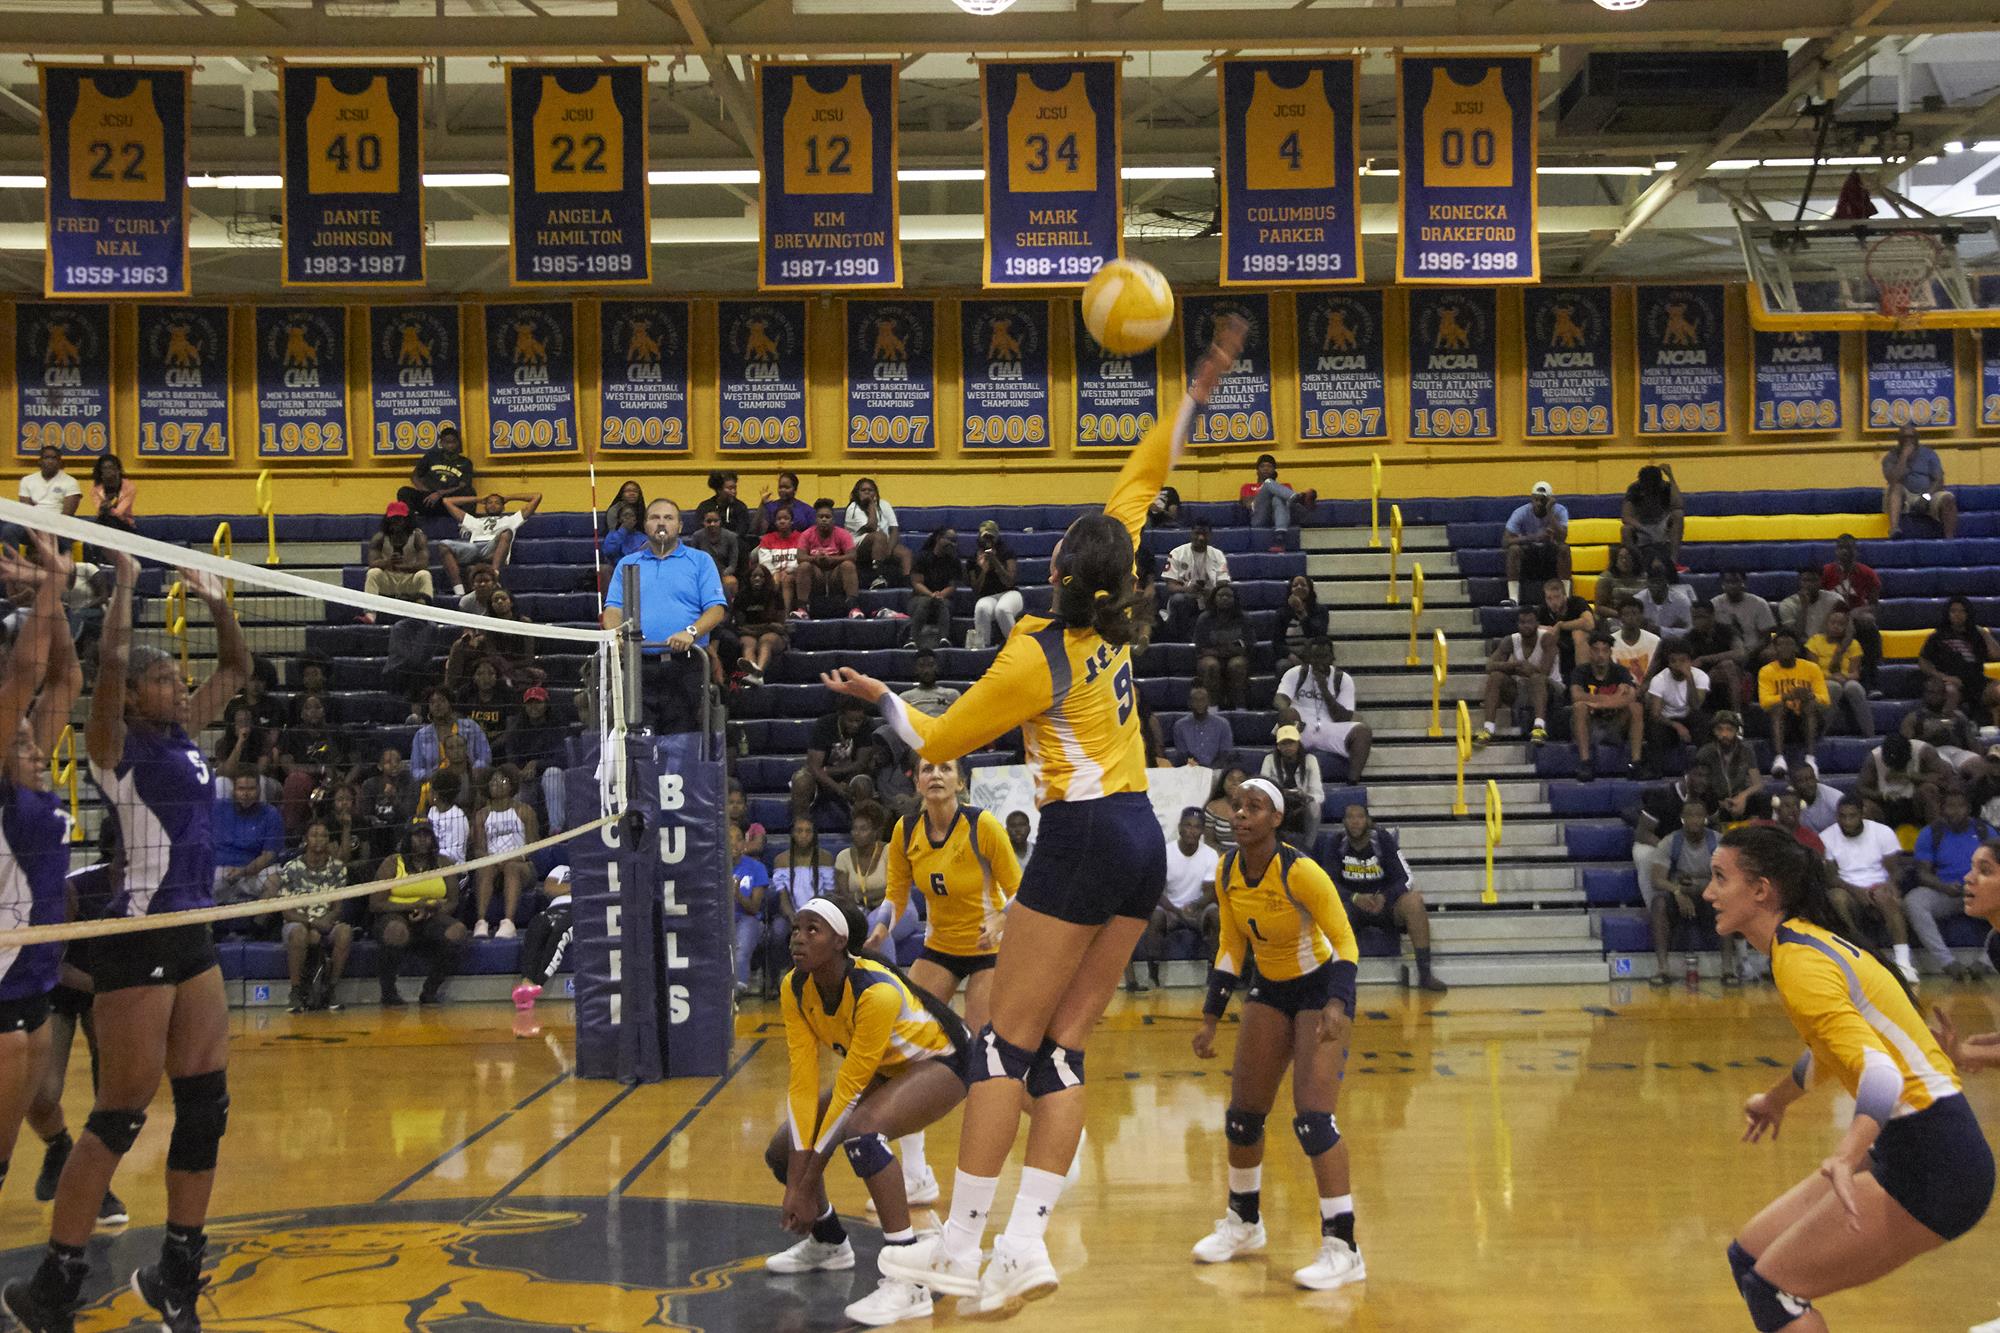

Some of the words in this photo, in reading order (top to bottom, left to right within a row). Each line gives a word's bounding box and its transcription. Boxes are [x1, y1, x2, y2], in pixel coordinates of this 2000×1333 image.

[336, 109, 369, 121] JCSU
[561, 108, 594, 122] JCSU
[811, 108, 844, 122] JCSU
[1035, 106, 1067, 120] JCSU
[1273, 105, 1306, 117] JCSU
[1451, 101, 1483, 114] JCSU
[100, 113, 133, 127] JCSU
[325, 134, 382, 173] 40
[550, 134, 607, 173] 22
[805, 135, 852, 176] 12
[1025, 132, 1079, 174] 34
[1279, 130, 1303, 171] 4
[1440, 128, 1495, 168] 00
[90, 142, 146, 181] 22
[323, 210, 380, 225] DANTE
[547, 209, 613, 224] ANGELA
[813, 212, 845, 227] KIM
[1029, 209, 1078, 225] MARK
[1247, 206, 1336, 222] COLUMBUS
[1429, 205, 1507, 220] KONECKA
[57, 218, 100, 234] FRED
[312, 231, 393, 247] JOHNSON
[537, 230, 623, 246] HAMILTON
[774, 232, 885, 249] BREWINGTON
[1016, 231, 1093, 247] SHERRILL
[1259, 228, 1324, 243] PARKER
[1421, 227, 1516, 242] DRAKEFORD
[96, 241, 141, 256] NEAL
[304, 256, 406, 274] 1983-1987
[532, 255, 632, 273] 1985-1989
[781, 258, 879, 277] 1987-1990
[1005, 256, 1104, 275] 1988-1992
[1242, 254, 1341, 272] 1989-1993
[1419, 252, 1518, 271] 1996-1998
[66, 266, 168, 284] 1959-1963
[1656, 350, 1707, 365] NCAA
[1772, 347, 1823, 362] NCAA
[1886, 344, 1936, 359] NCAA
[1317, 355, 1366, 371] NCAA
[1428, 354, 1478, 369] NCAA
[1543, 352, 1595, 367] NCAA
[1305, 374, 1328, 382] MEN'S
[1330, 372, 1378, 381] BASKETBALL
[1442, 372, 1489, 380] BASKETBALL
[1532, 370, 1555, 378] MEN'S
[1644, 368, 1668, 376] MEN'S
[1757, 373, 1787, 382] SOUTH
[1790, 372, 1836, 382] ATLANTIC
[1869, 371, 1900, 380] SOUTH
[1904, 368, 1952, 379] ATLANTIC
[880, 383, 924, 391] BASKETBALL
[1083, 381, 1105, 389] MEN'S
[1302, 382, 1332, 391] SOUTH
[1336, 380, 1381, 390] ATLANTIC
[1412, 380, 1442, 390] SOUTH
[1447, 380, 1492, 389] ATLANTIC
[1529, 378, 1559, 388] SOUTH
[1562, 377, 1609, 387] ATLANTIC
[1642, 376, 1673, 385] SOUTH
[1676, 375, 1722, 384] ATLANTIC
[1771, 382, 1824, 391] REGIONALS
[1884, 380, 1937, 389] REGIONALS
[25, 388, 48, 396] MEN'S
[173, 391, 218, 399] BASKETBALL
[381, 391, 404, 399] MEN'S
[406, 390, 451, 398] BASKETBALL
[496, 387, 519, 395] MEN'S
[521, 386, 566, 394] BASKETBALL
[610, 384, 632, 392] MEN'S
[634, 384, 678, 392] BASKETBALL
[852, 391, 893, 399] WESTERN
[967, 391, 1008, 399] WESTERN
[1010, 391, 1044, 399] DIVISION
[1080, 390, 1119, 398] WESTERN
[1121, 389, 1154, 397] DIVISION
[1223, 384, 1269, 394] ATLANTIC
[1316, 391, 1367, 400] REGIONALS
[1426, 390, 1479, 399] REGIONALS
[1542, 388, 1595, 397] REGIONALS
[1655, 385, 1708, 394] REGIONALS
[376, 399, 420, 408] SOUTHERN
[422, 398, 457, 407] DIVISION
[492, 396, 534, 405] WESTERN
[536, 394, 570, 402] DIVISION
[605, 393, 646, 401] WESTERN
[649, 393, 683, 401] DIVISION
[724, 392, 765, 400] WESTERN
[767, 392, 801, 400] DIVISION
[1094, 398, 1139, 406] CHAMPIONS
[24, 405, 102, 416] RUNNER-UP
[141, 400, 187, 408] SOUTHERN
[189, 400, 225, 408] DIVISION
[260, 400, 305, 408] SOUTHERN
[307, 400, 343, 408] DIVISION
[392, 407, 441, 415] CHAMPIONS
[508, 403, 556, 413] CHAMPIONS
[620, 401, 667, 409] CHAMPIONS
[739, 401, 786, 409] CHAMPIONS
[867, 400, 914, 408] CHAMPIONS
[1871, 396, 1951, 426] 2002
[159, 409, 208, 417] CHAMPIONS
[278, 409, 327, 417] CHAMPIONS
[1531, 405, 1608, 434] 1992
[1644, 401, 1721, 431] 1995
[851, 415, 929, 443] 2007
[966, 415, 1045, 443] 2008
[1080, 412, 1155, 442] 2009
[1193, 411, 1269, 442] 1960
[1306, 407, 1381, 436] 1987
[1415, 408, 1491, 436] 1991
[22, 422, 106, 451] 2006
[142, 422, 225, 451] 1974
[262, 422, 344, 451] 1982
[493, 418, 571, 448] 2001
[604, 416, 682, 445] 2002
[723, 416, 801, 444] 2006
[1113, 661, 1134, 726] 9
[186, 750, 210, 785] 5
[930, 873, 949, 896] 6
[658, 773, 691, 1024] BULLS
[1248, 918, 1268, 941] 1
